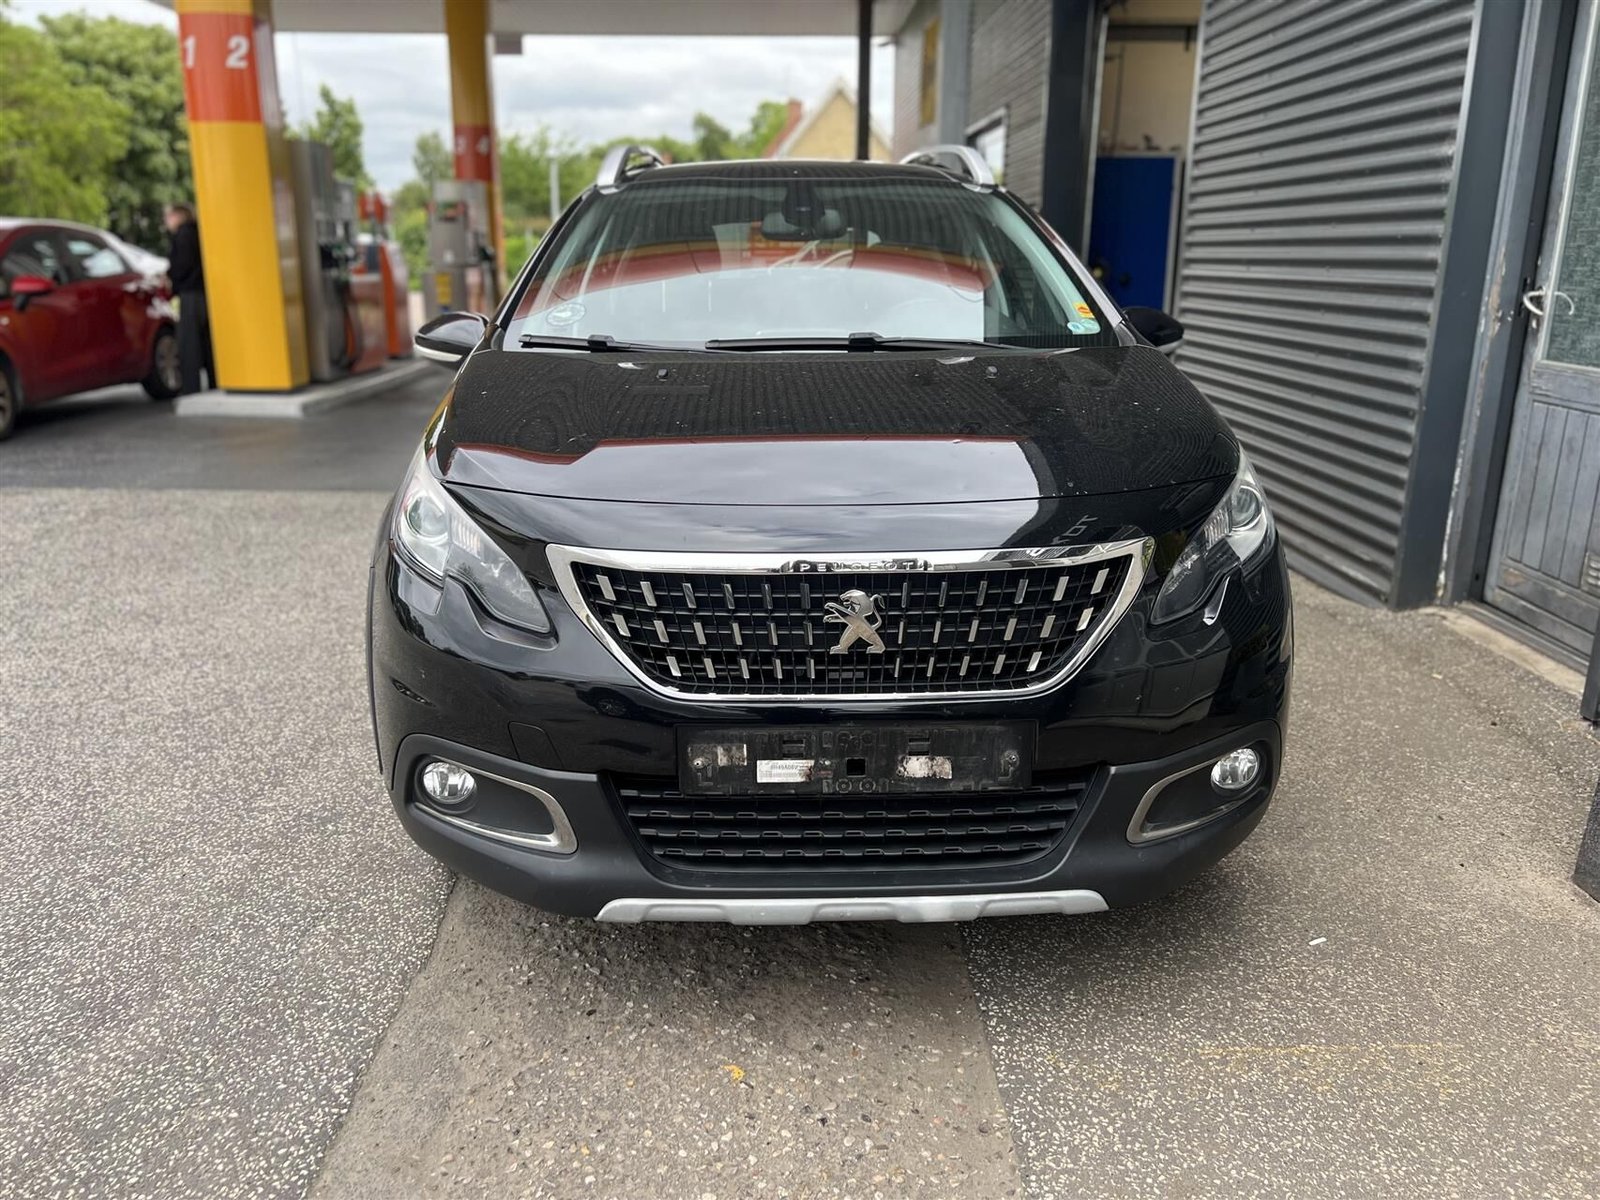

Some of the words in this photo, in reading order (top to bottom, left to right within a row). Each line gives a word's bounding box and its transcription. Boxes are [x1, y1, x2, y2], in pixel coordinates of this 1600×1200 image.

[183, 34, 196, 69] 1
[225, 34, 249, 69] 2
[799, 561, 914, 572] PEUGEOT
